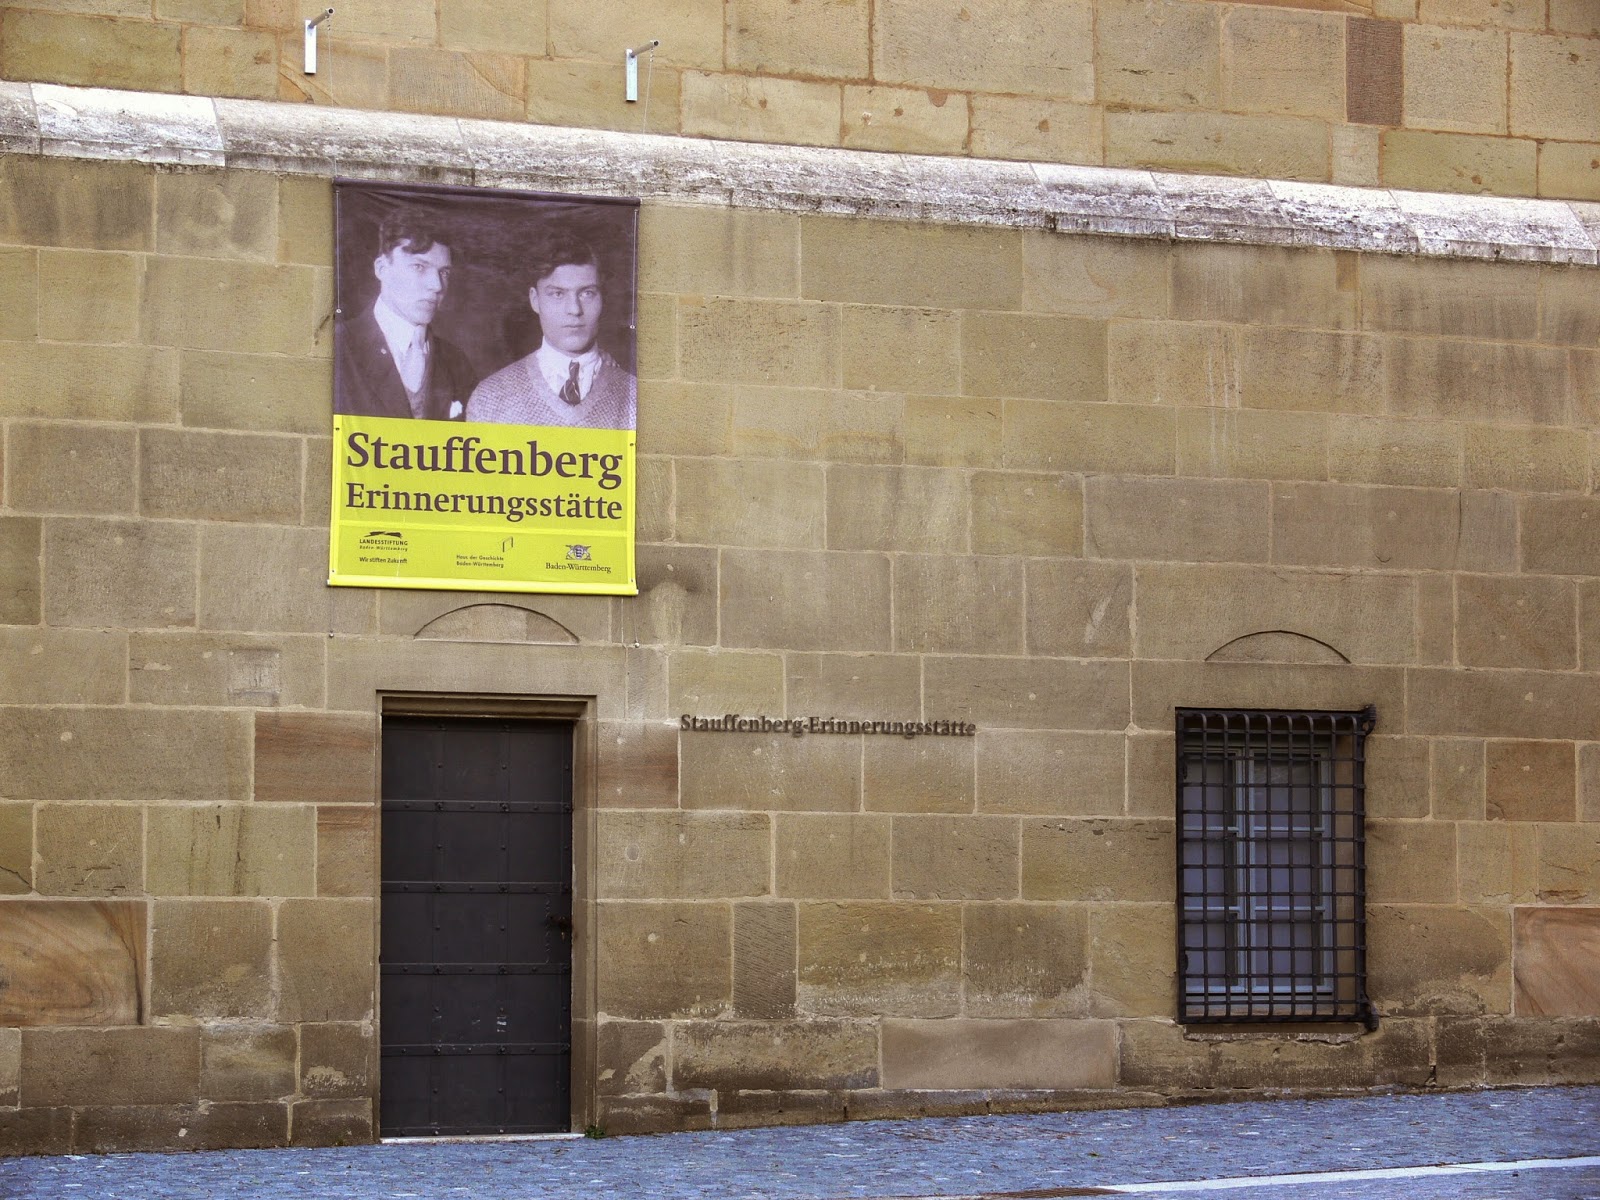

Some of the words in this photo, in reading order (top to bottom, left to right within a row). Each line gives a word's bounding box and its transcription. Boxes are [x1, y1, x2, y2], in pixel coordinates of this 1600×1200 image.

[347, 431, 623, 490] Stauffenberg
[346, 482, 623, 522] Erinnerungsstätte
[359, 538, 408, 546] LANDESSTIFTUNG
[545, 562, 611, 573] Baden-Württemberg
[680, 713, 976, 739] Stauffenberg-Erinnerungsstätte
